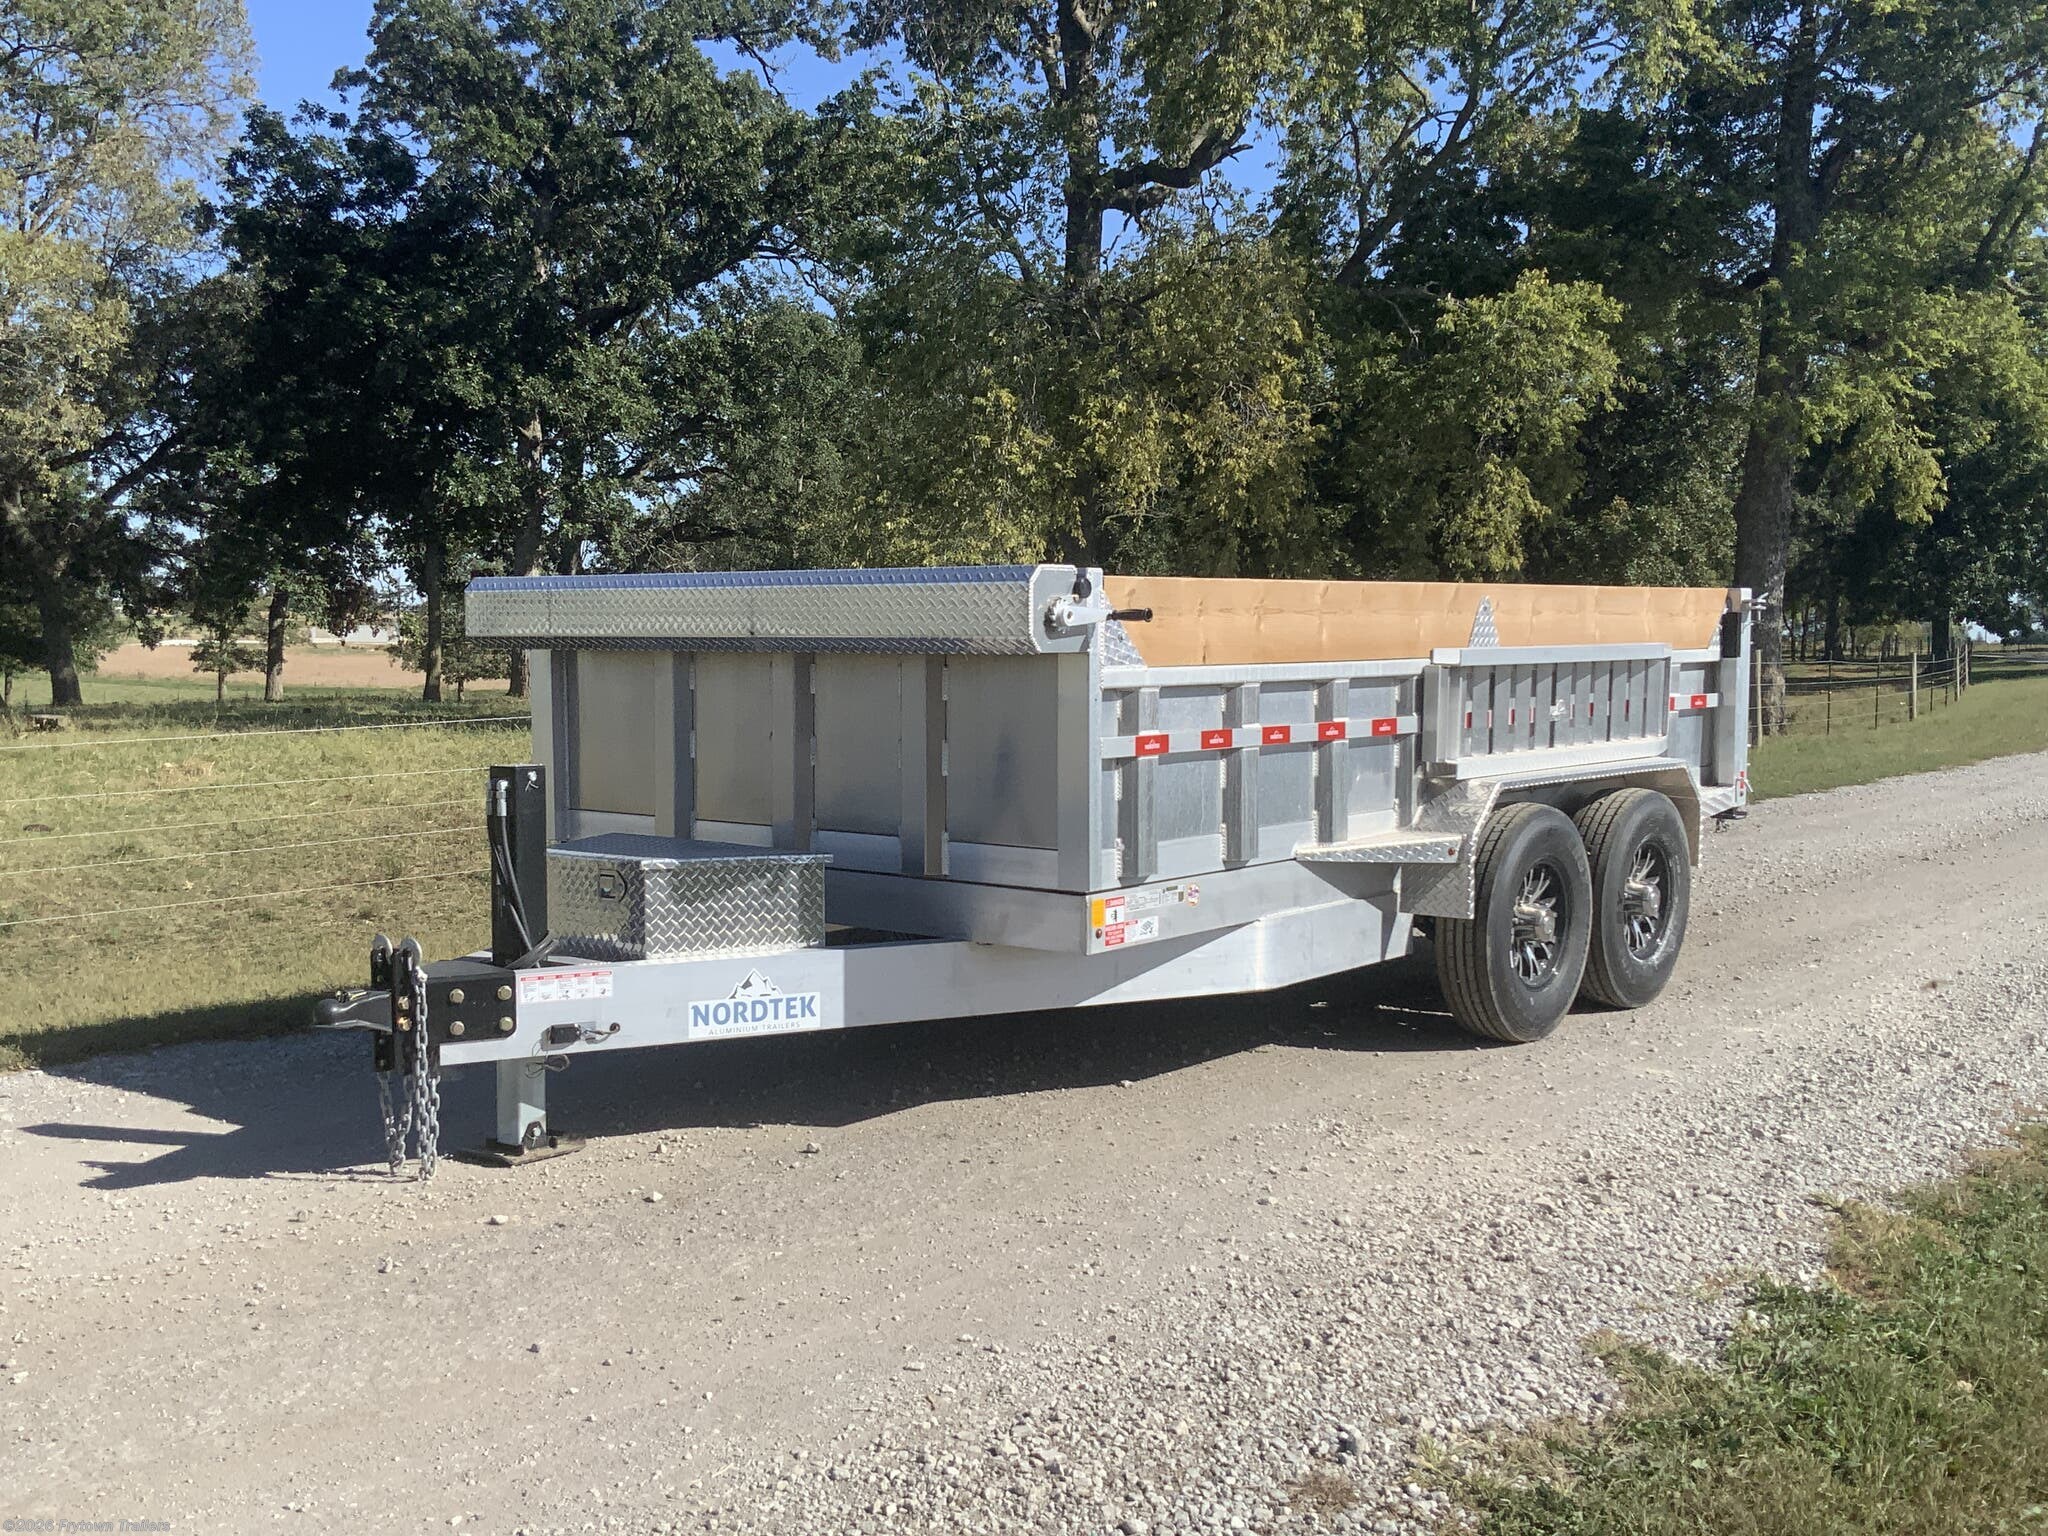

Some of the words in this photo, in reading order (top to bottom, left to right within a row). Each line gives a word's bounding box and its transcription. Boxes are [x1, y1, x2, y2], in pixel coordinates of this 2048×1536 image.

[691, 995, 816, 1027] NORDTEK
[708, 1025, 759, 1035] ALUMINIUM
[762, 1021, 801, 1031] TRAILERS
